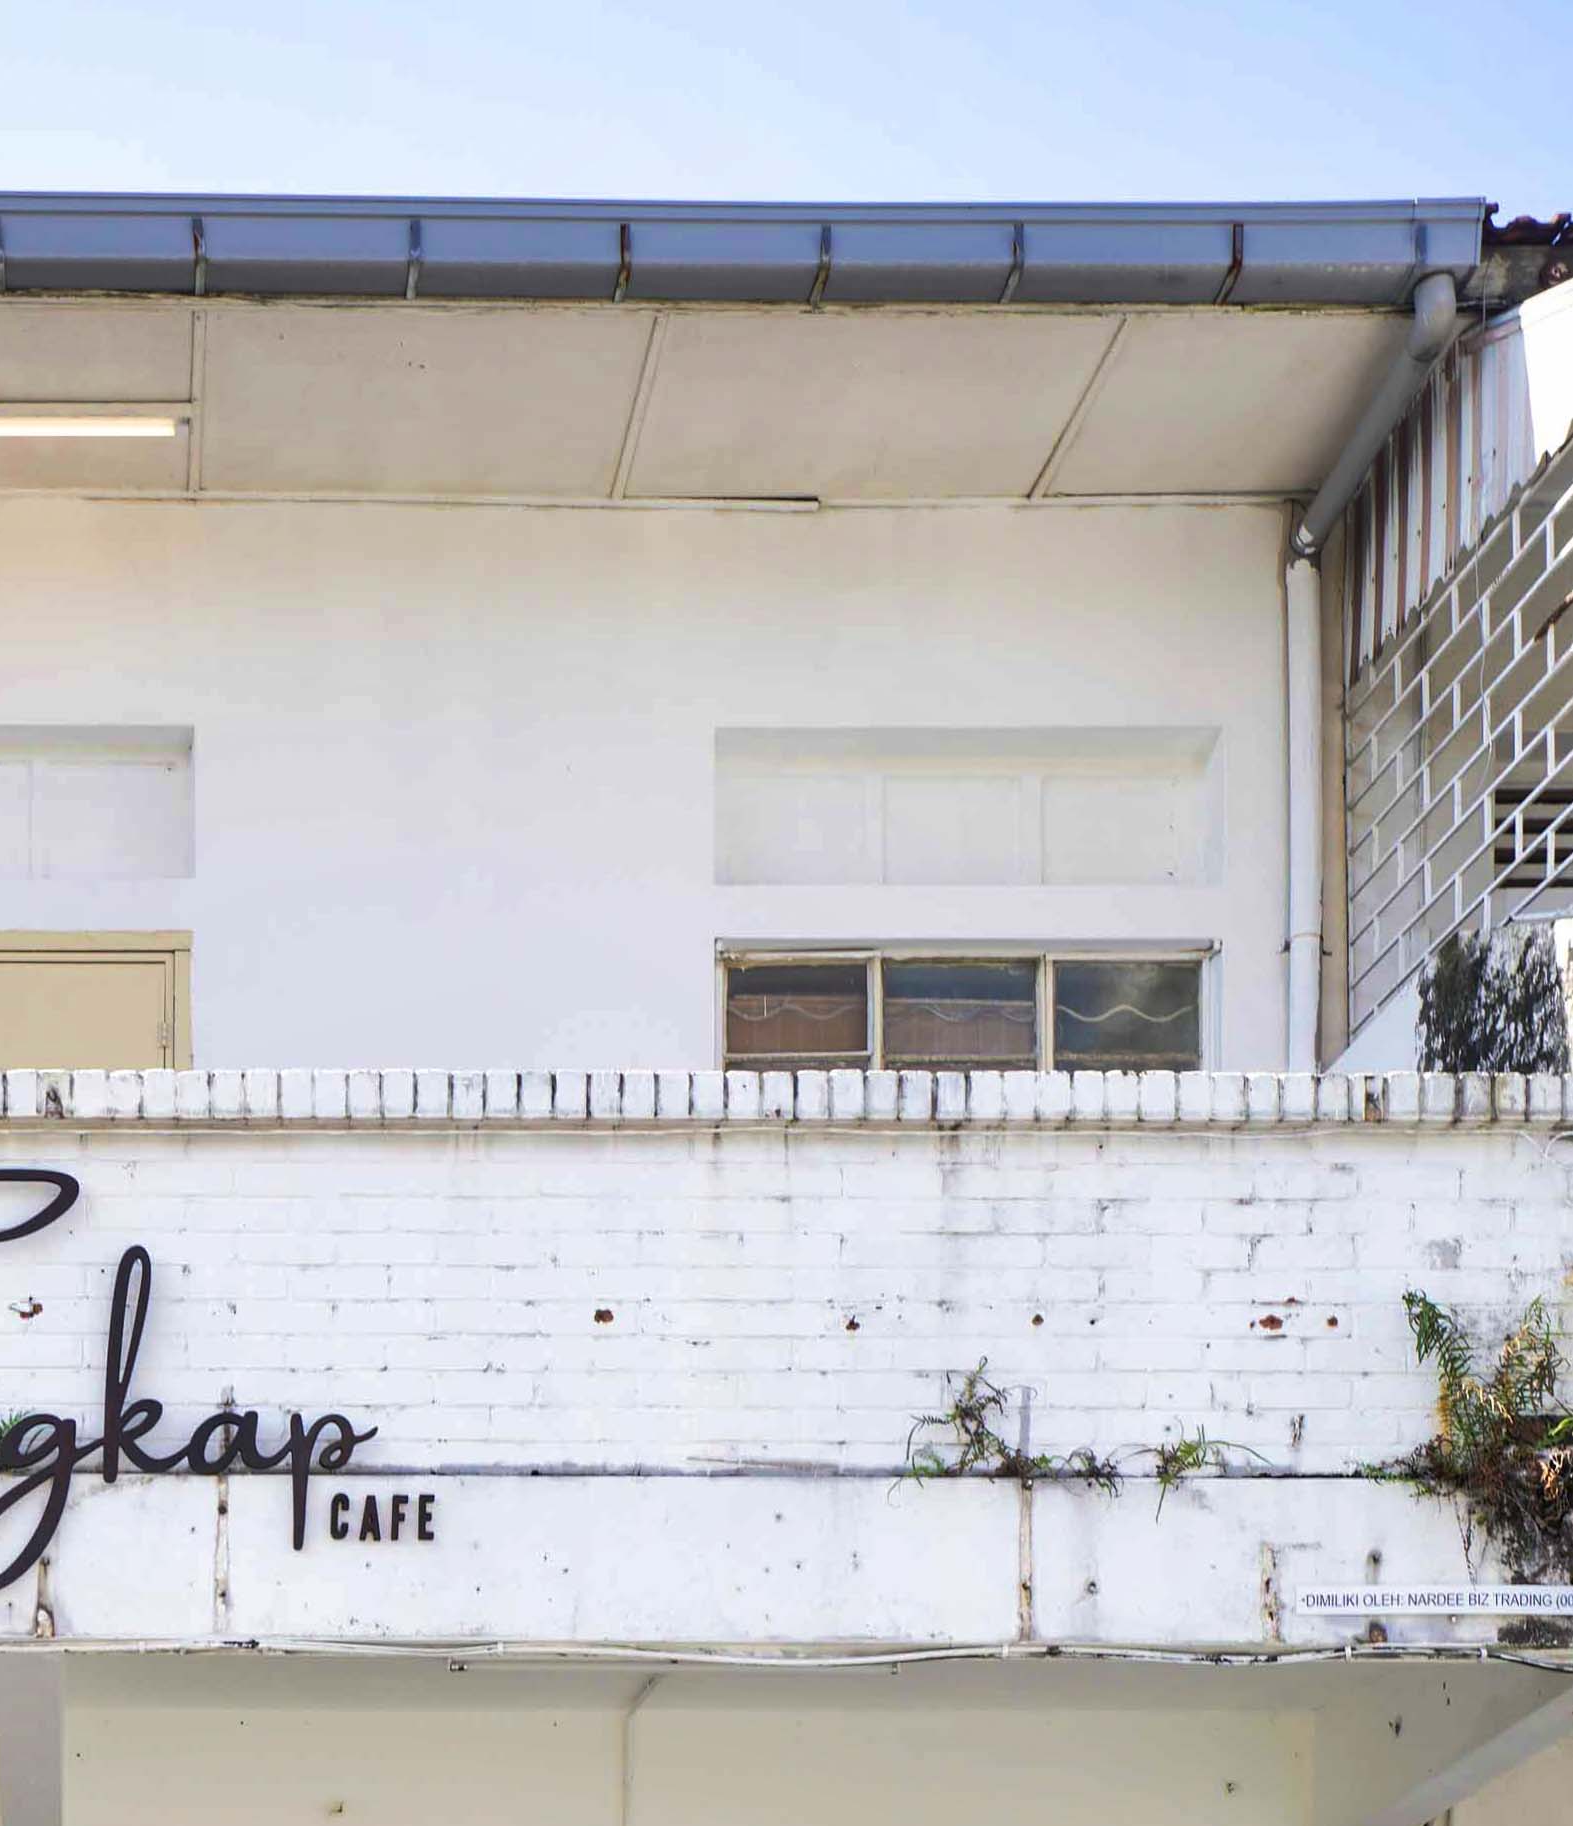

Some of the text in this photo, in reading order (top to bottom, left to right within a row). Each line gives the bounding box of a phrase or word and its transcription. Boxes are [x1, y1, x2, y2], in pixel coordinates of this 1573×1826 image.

[329, 1492, 437, 1542] CAFE
[1305, 1594, 1359, 1608] DIMILIKI
[1362, 1594, 1404, 1608] OLEH:
[1407, 1594, 1465, 1607] NARDEE
[1468, 1594, 1490, 1607] BIZ
[1494, 1593, 1553, 1607] TRADING
